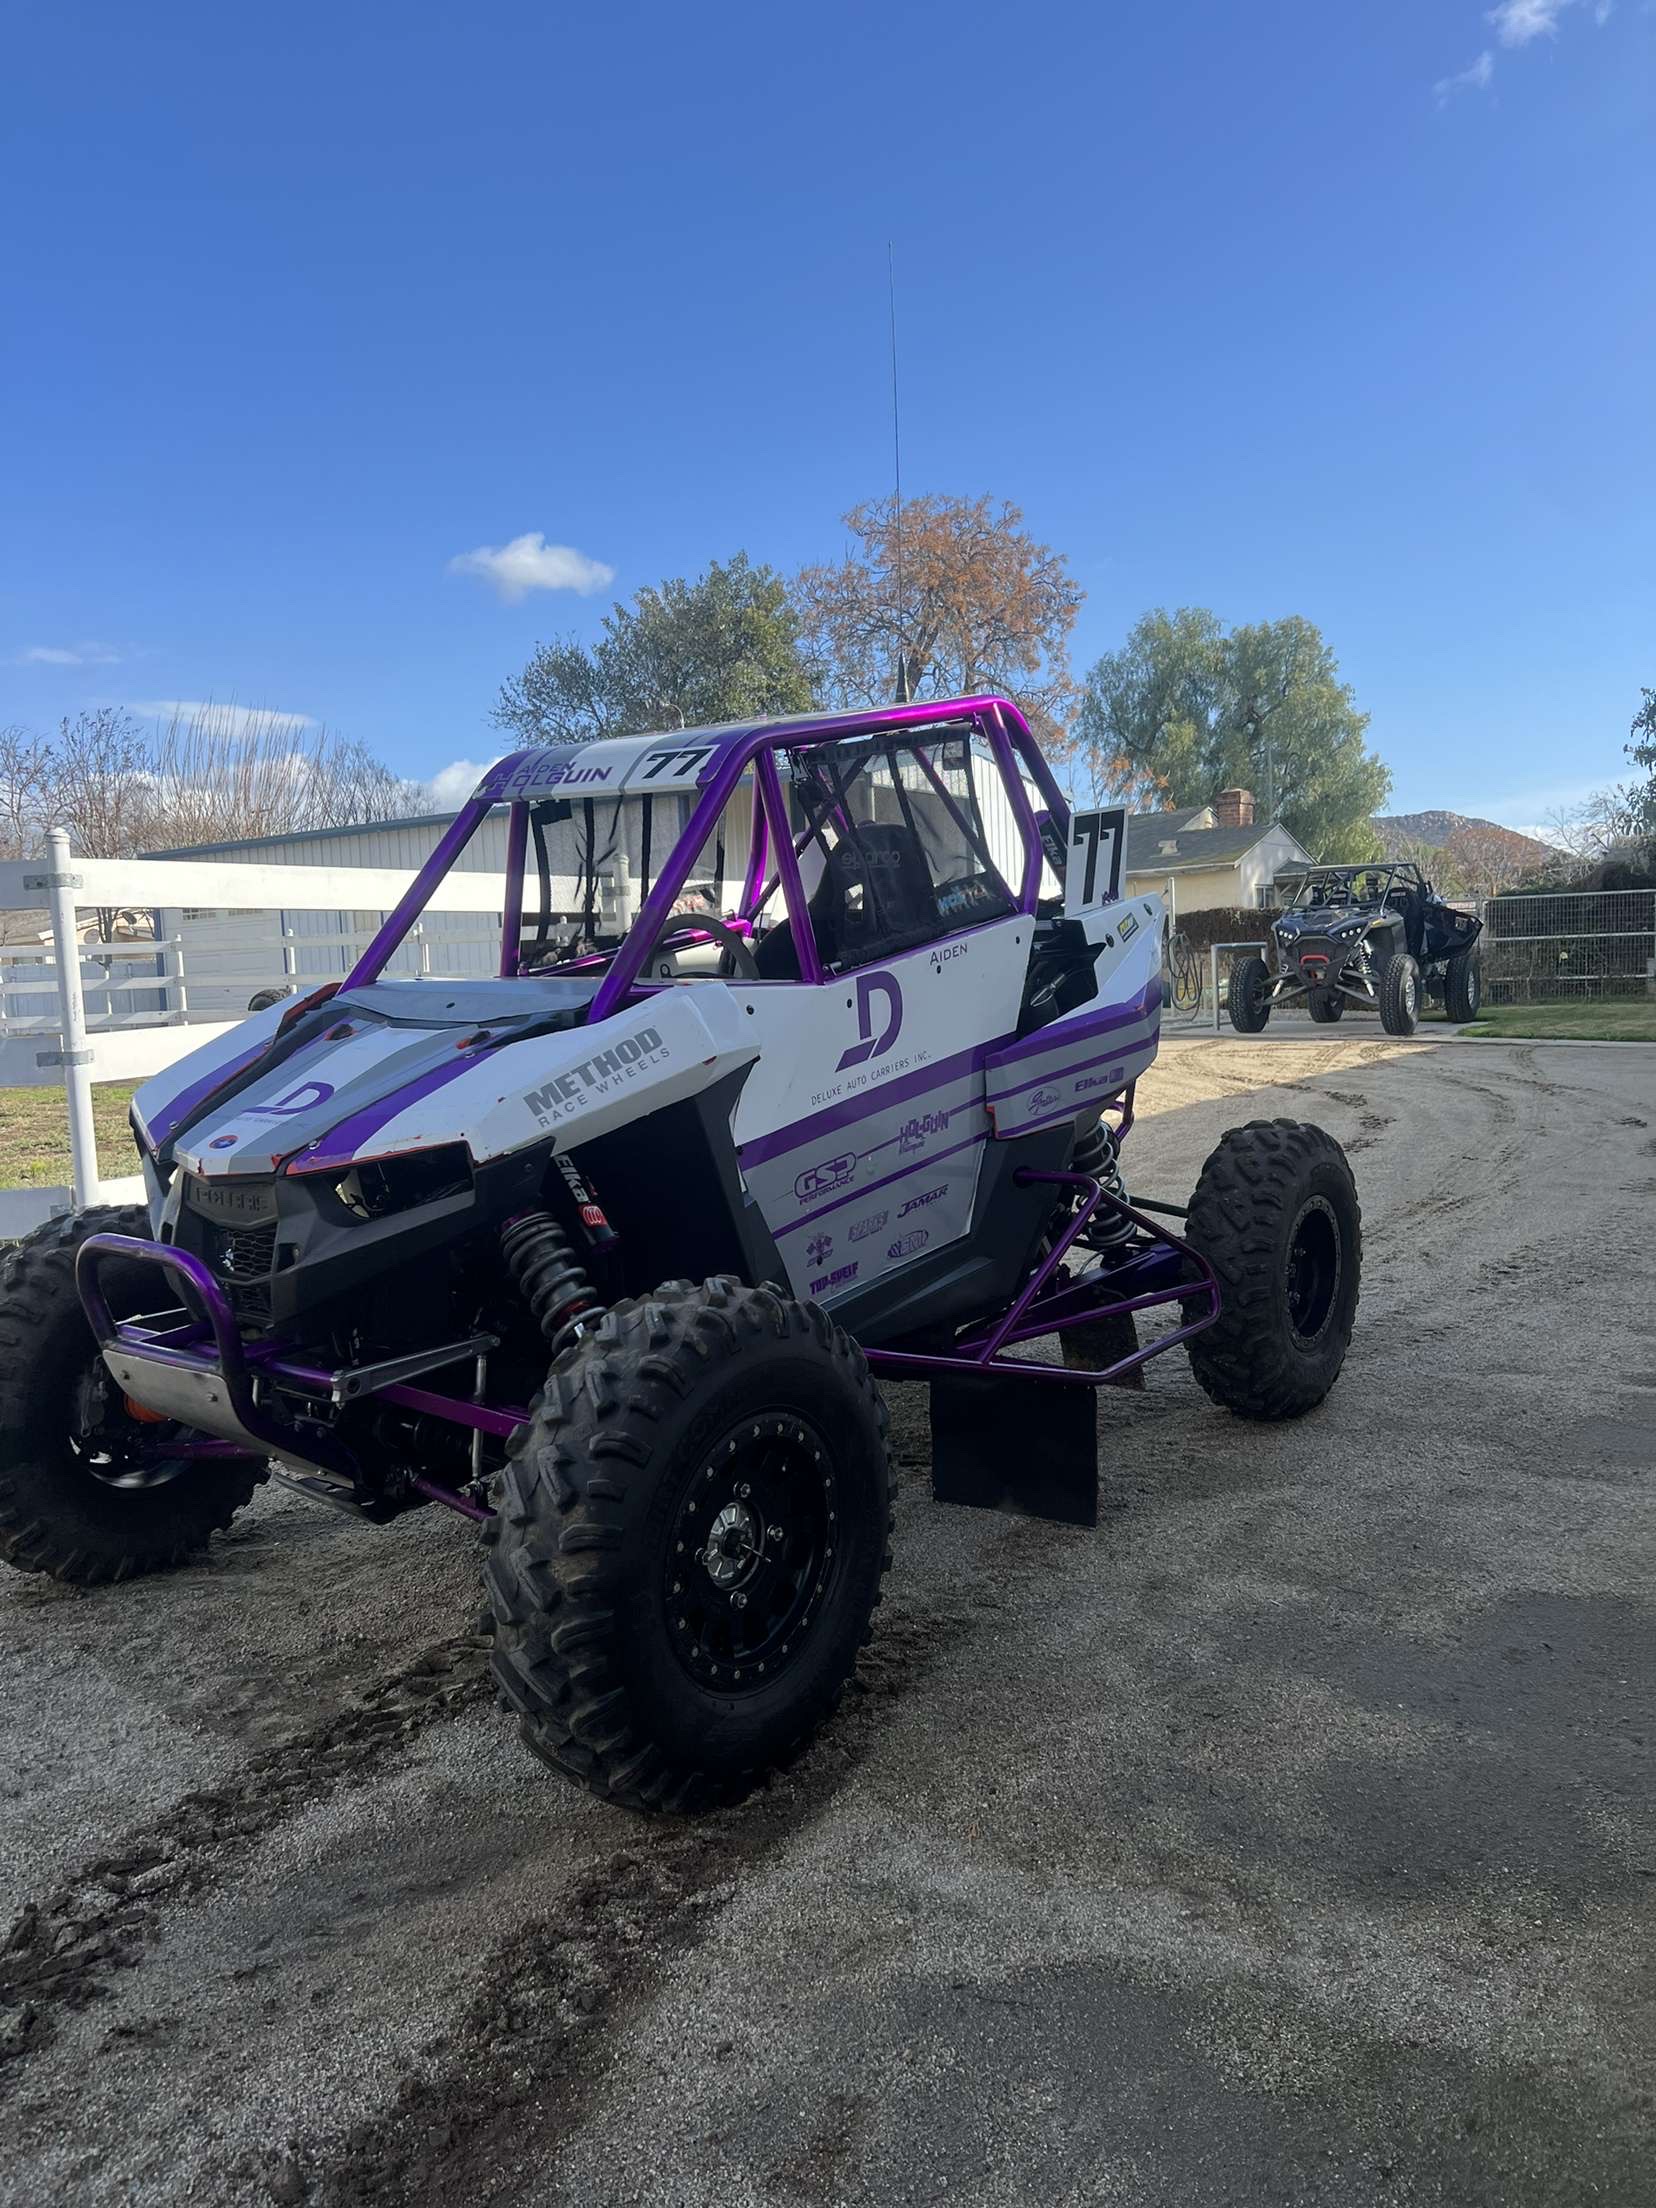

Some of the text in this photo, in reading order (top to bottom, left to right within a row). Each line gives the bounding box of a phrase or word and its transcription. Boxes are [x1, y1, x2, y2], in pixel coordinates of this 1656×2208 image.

[494, 766, 614, 788] HOLGUIN
[519, 761, 576, 774] AIDEN
[642, 749, 712, 779] 77
[1073, 809, 1125, 905] 77
[929, 944, 968, 965] AIDEN
[523, 1028, 663, 1117] METHOD
[538, 1047, 670, 1128] RACE WHEELS
[811, 1084, 842, 1106] DELUXE
[847, 1074, 867, 1090] AUTO
[871, 1059, 910, 1080] CARRIERS
[795, 1151, 857, 1199] GSP
